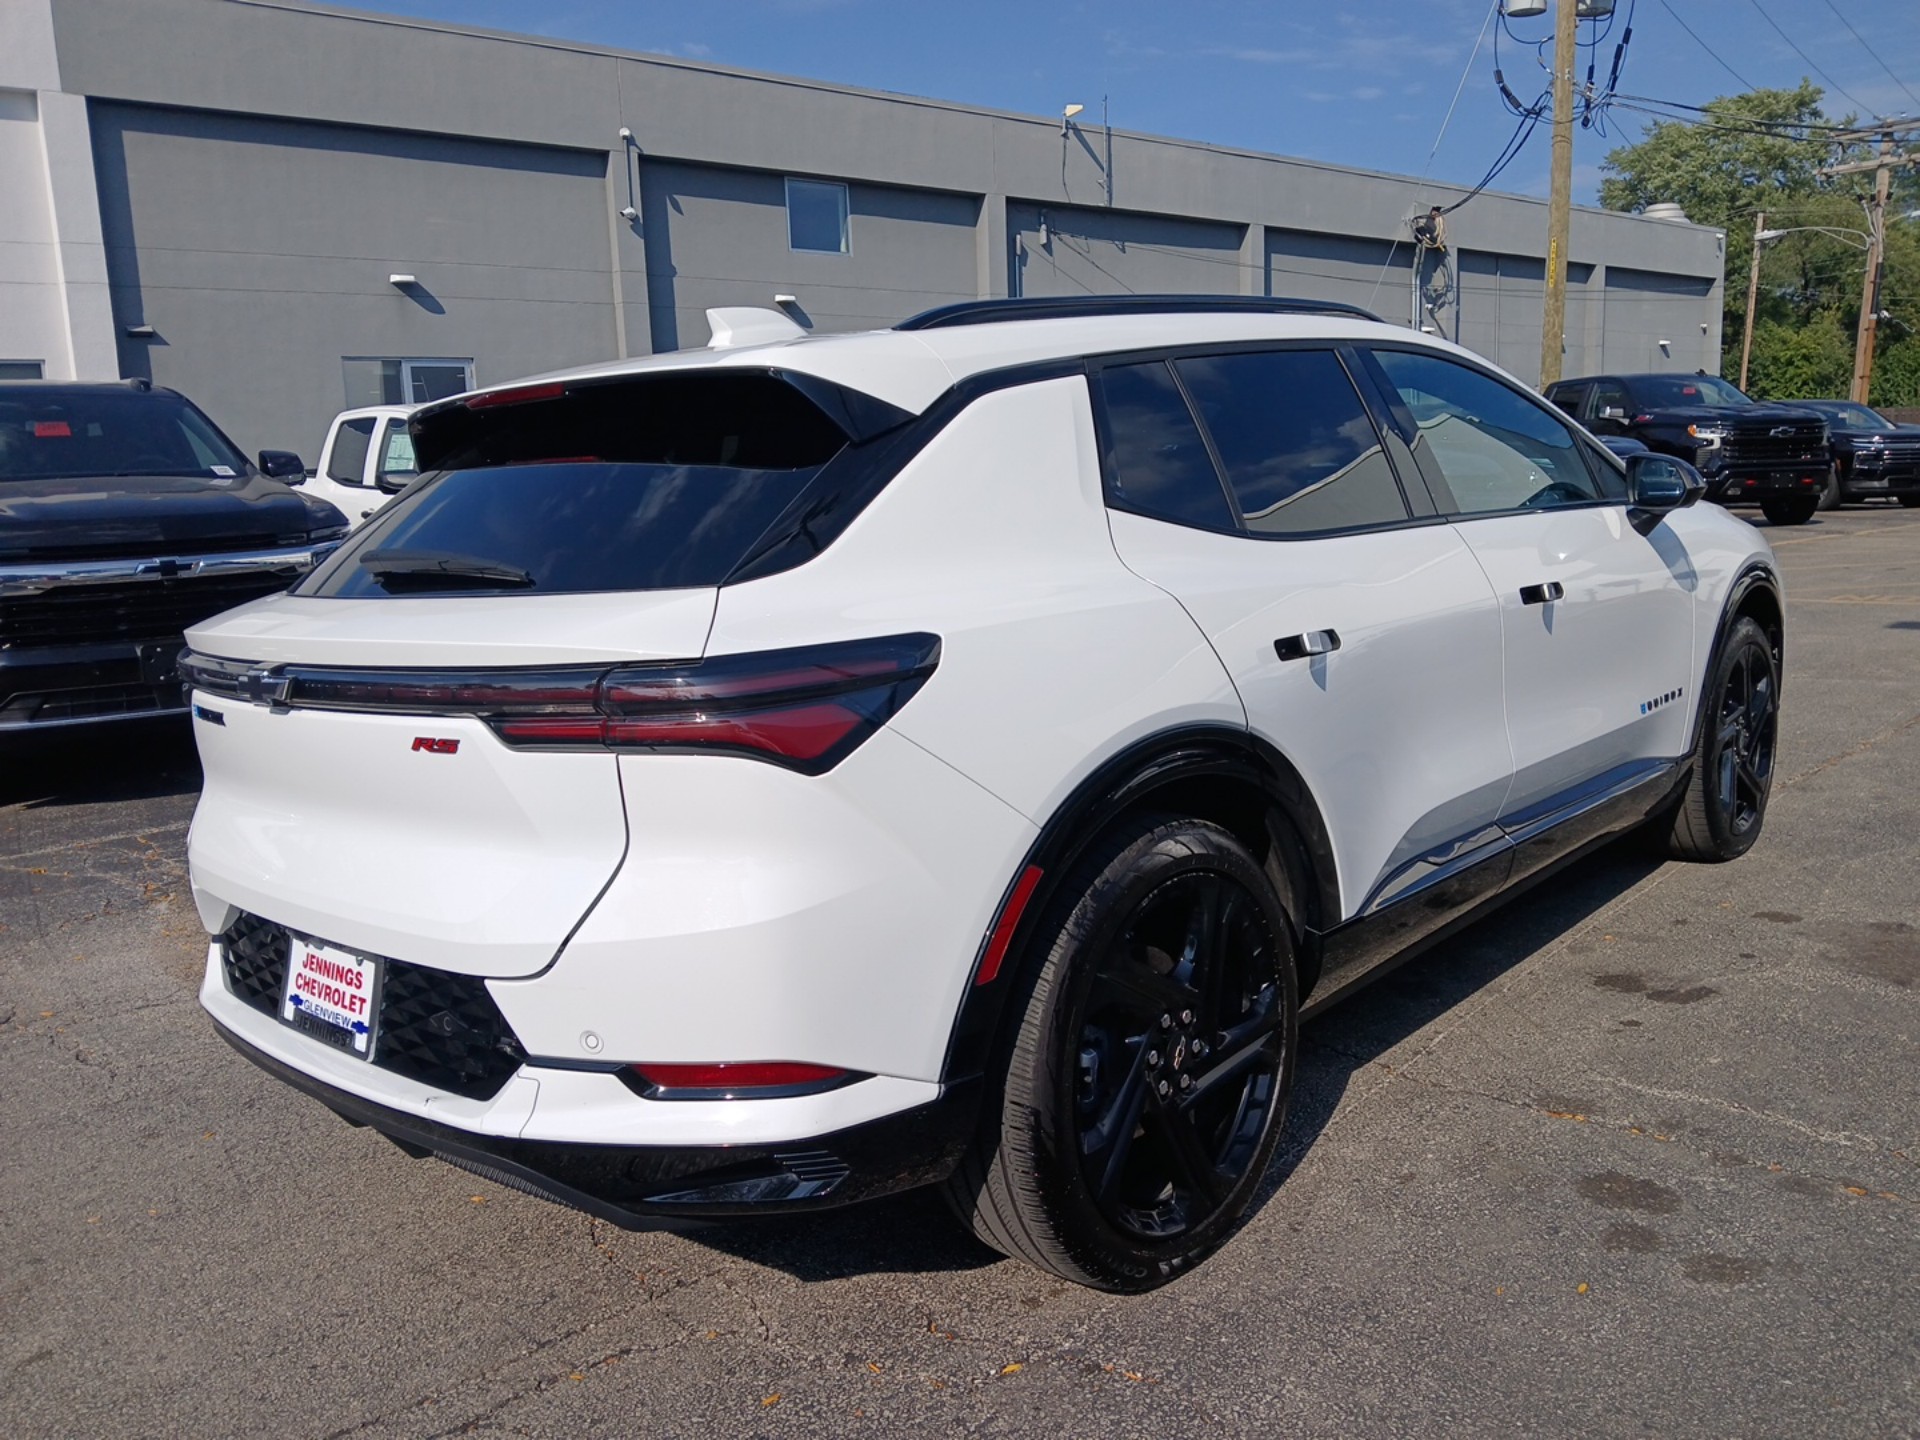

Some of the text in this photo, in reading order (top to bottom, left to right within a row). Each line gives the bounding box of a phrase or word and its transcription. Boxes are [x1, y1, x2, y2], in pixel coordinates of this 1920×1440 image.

[411, 736, 461, 755] RS
[302, 952, 364, 991] JENNINGS
[295, 971, 368, 1016] CHEVROLET
[303, 998, 352, 1030] GLENVIEW
